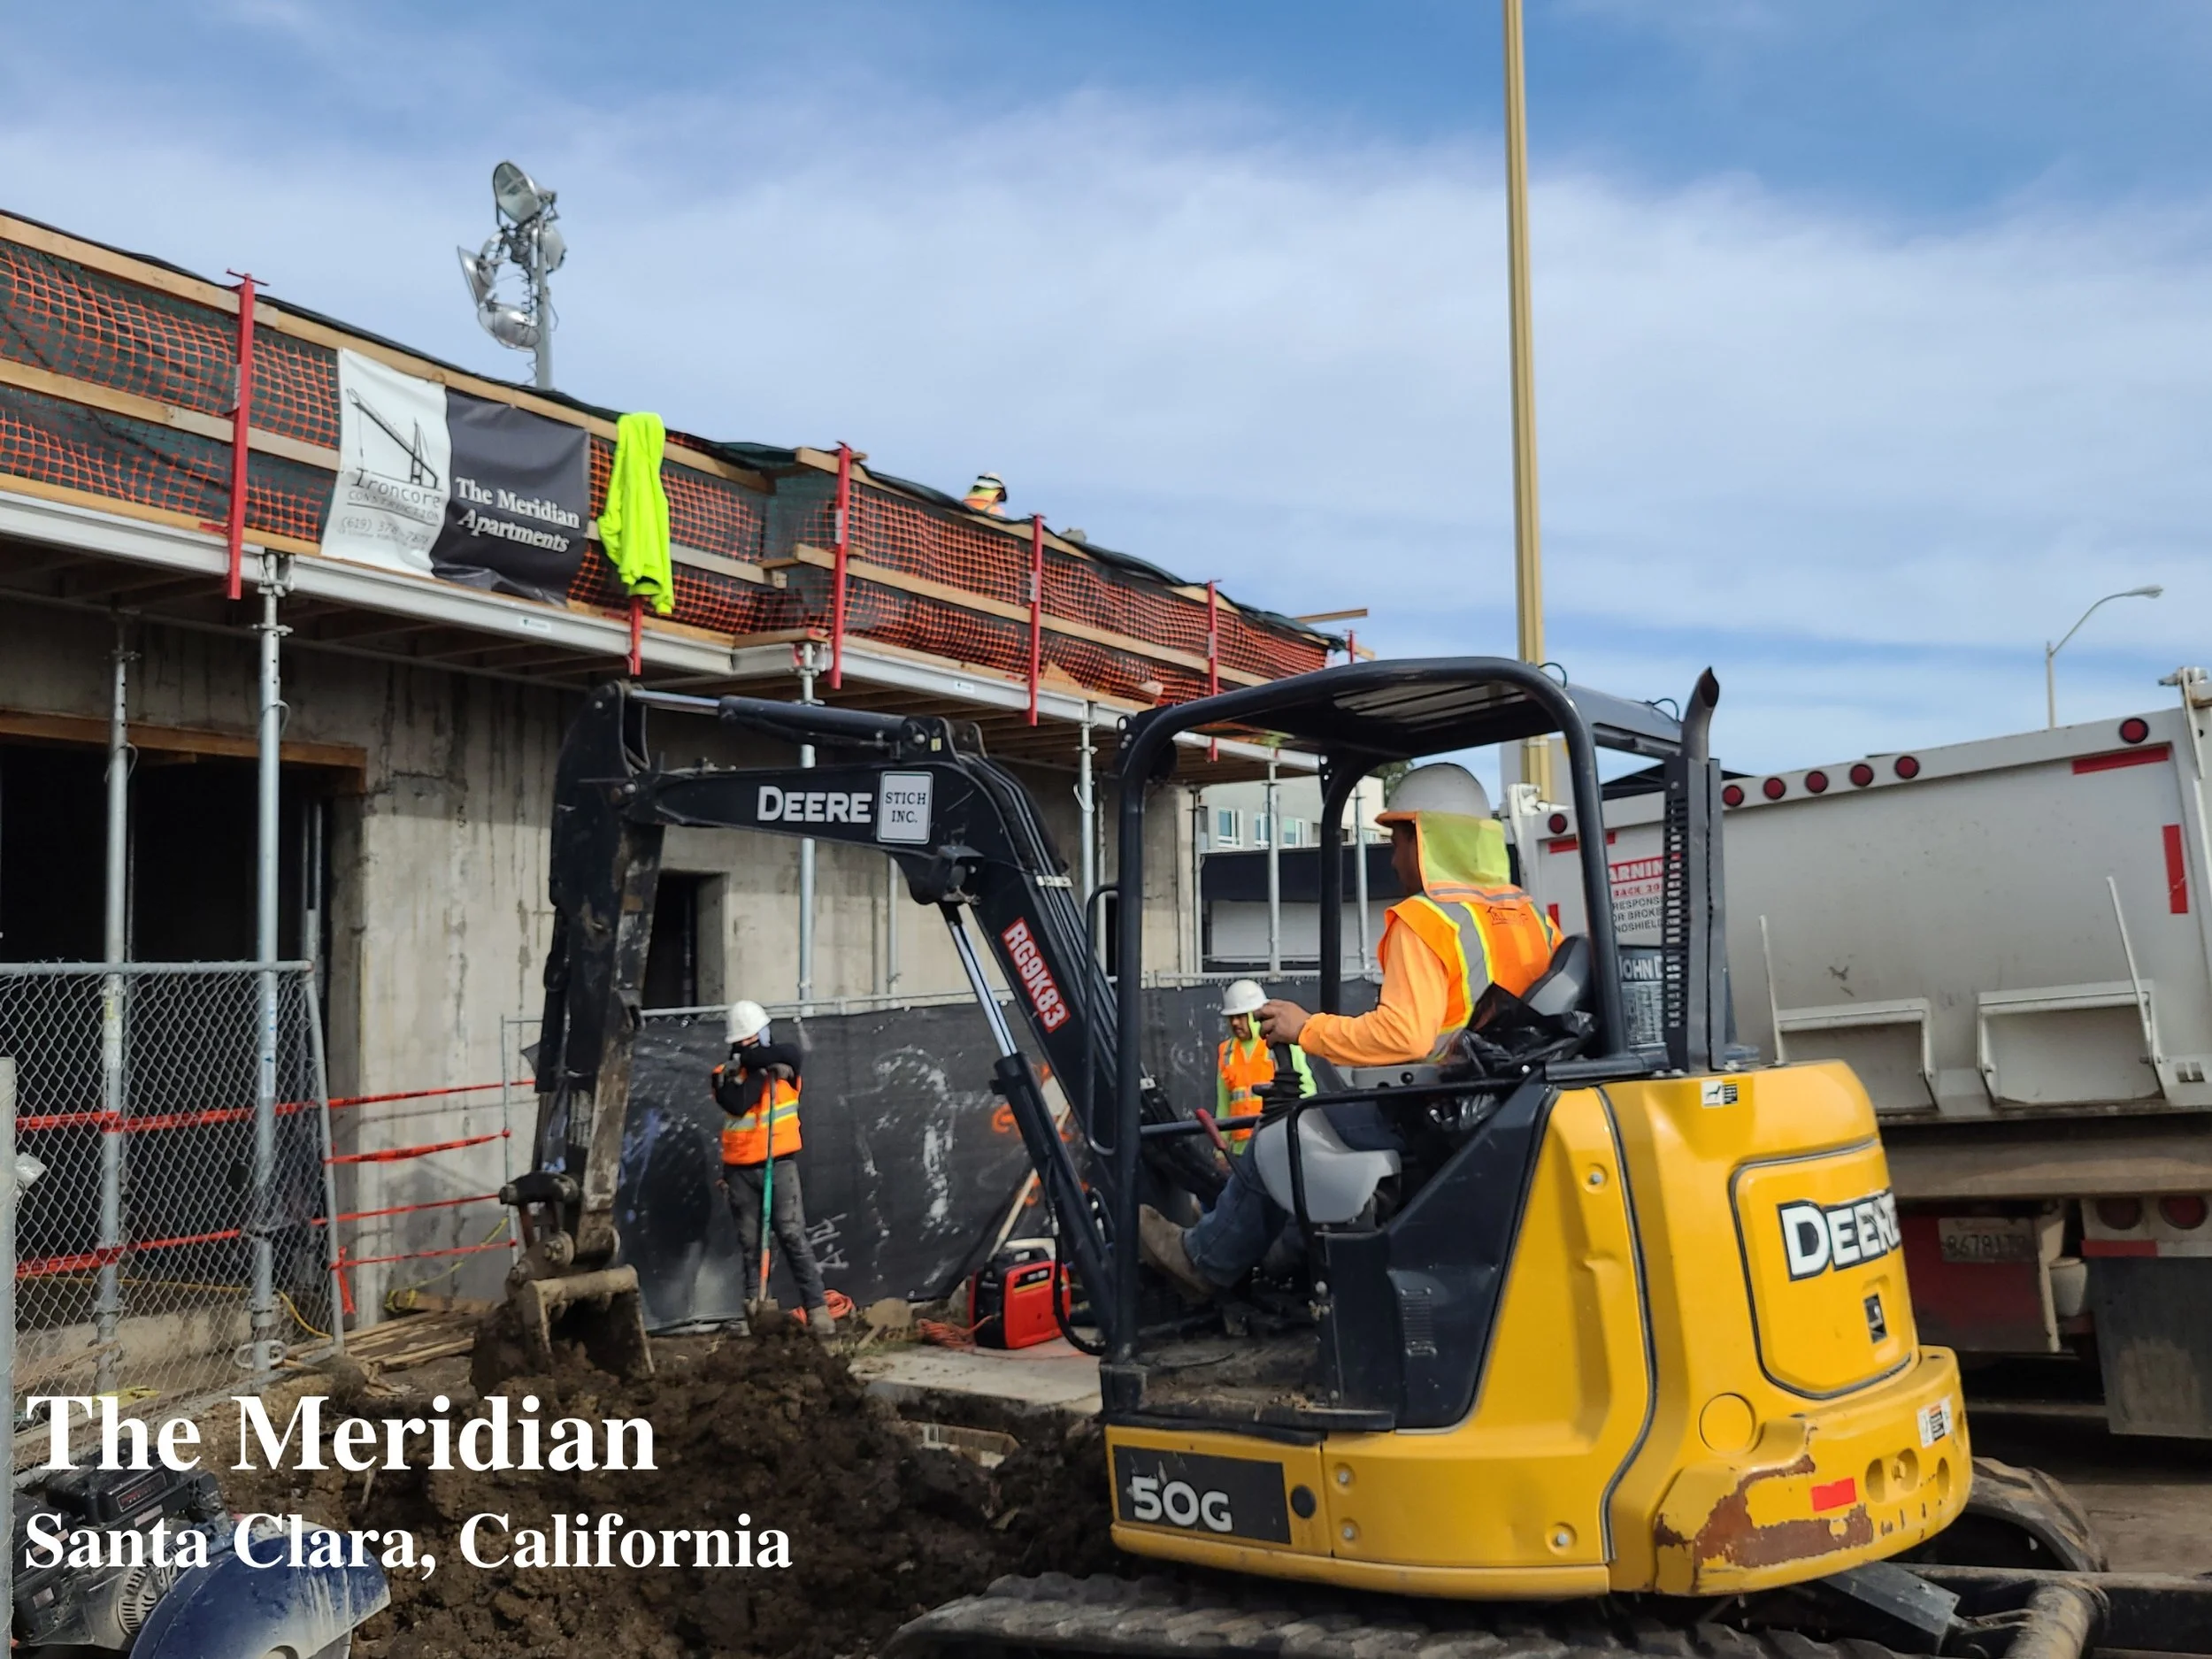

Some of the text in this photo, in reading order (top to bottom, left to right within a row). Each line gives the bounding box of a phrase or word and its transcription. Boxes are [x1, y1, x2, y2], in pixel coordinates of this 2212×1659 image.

[351, 467, 441, 508] Ironcore
[455, 476, 580, 528] The Meridian
[457, 508, 570, 553] Apartments
[757, 786, 872, 823] DEERE
[885, 791, 926, 806] STICH
[891, 810, 918, 824] INC.
[1609, 859, 1663, 882] ARNIN
[1612, 896, 1661, 910] RESPONS
[1628, 908, 1663, 920] BROKE
[1005, 921, 1066, 1027] RG9K83
[1132, 1476, 1233, 1532] 50G
